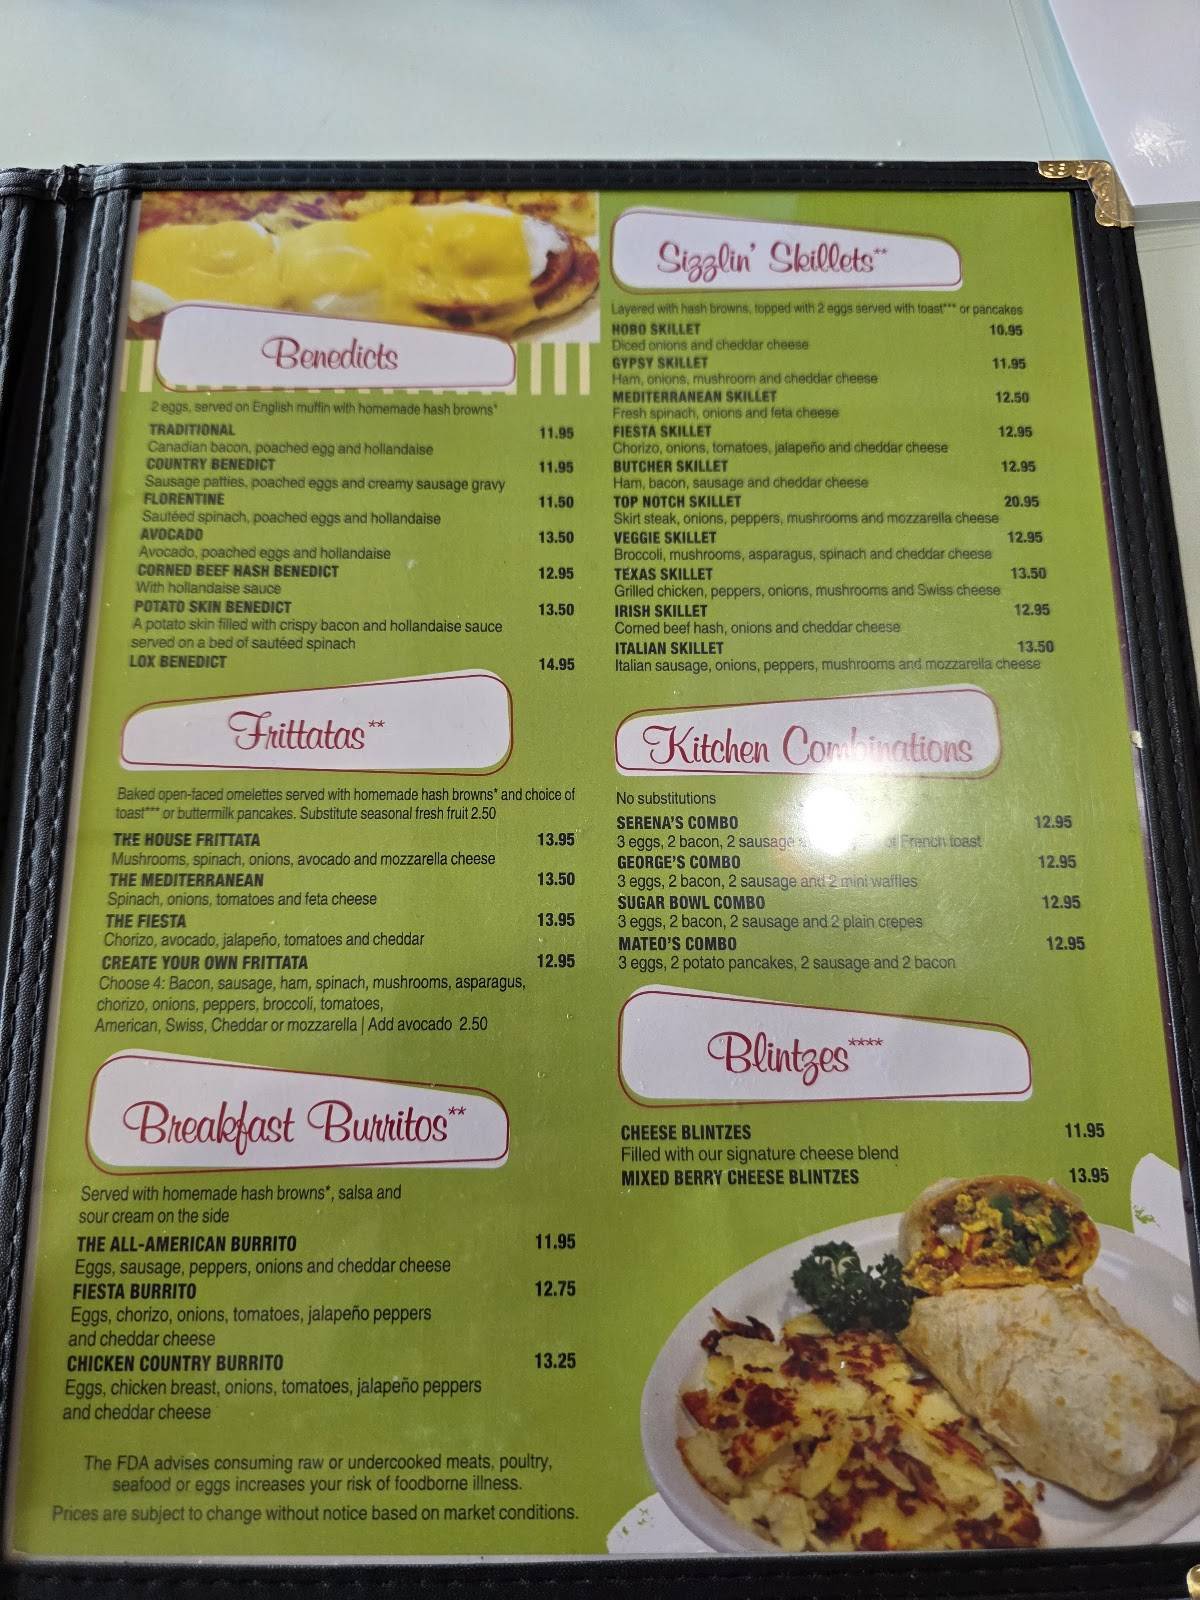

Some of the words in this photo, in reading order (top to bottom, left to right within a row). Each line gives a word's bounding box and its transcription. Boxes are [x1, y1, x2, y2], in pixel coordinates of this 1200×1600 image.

[657, 241, 755, 282] Sizzlin'
[611, 323, 646, 335] HOBO
[650, 322, 700, 335] SKILLET
[989, 323, 1023, 336] 10.95
[261, 337, 398, 370] Benedicts
[612, 356, 653, 369] GYPSY
[657, 356, 708, 369] SKILLET
[992, 357, 1026, 369] 11.95
[612, 389, 721, 403] MEDITERRANEAN
[725, 389, 776, 402] SKILLET
[995, 391, 1029, 403] 12.50
[149, 423, 235, 436] TRADITIONAL
[539, 426, 574, 439] 11.95
[613, 425, 656, 438] FIESTA
[660, 425, 711, 437] SKILLET
[998, 425, 1032, 438] 12.95
[146, 457, 207, 470] COUNTRY
[210, 458, 275, 471] BENEDICT
[539, 460, 573, 473] 11.95
[613, 460, 672, 473] BUTCHER
[676, 459, 728, 472] SKILLET
[1001, 460, 1036, 472] 12.95
[143, 492, 224, 505] FLORENTINE
[538, 495, 574, 508] 11.50
[613, 495, 638, 508] TOP
[642, 495, 684, 508] NOTCH
[689, 495, 741, 508] SKILLET
[1004, 495, 1039, 508] 20.95
[139, 528, 203, 541] AVOCADO
[538, 530, 574, 544] 13.50
[613, 531, 660, 544] VEGGIE
[664, 531, 716, 544] SKILLET
[1007, 530, 1043, 543] 12.95
[137, 564, 192, 576] CORNED
[195, 564, 229, 577] BEEF
[233, 564, 269, 577] HASH
[273, 564, 339, 578] BENEDICT
[538, 566, 574, 580] 12.95
[614, 567, 656, 581] TEXAS
[660, 567, 712, 581] SKILLET
[1010, 567, 1046, 579] 13.50
[136, 581, 164, 593] With
[167, 581, 240, 594] hollandaise
[242, 583, 281, 595] sauce
[614, 583, 653, 597] Grilled
[656, 584, 707, 599] chicken,
[710, 586, 764, 599] peppers,
[767, 583, 812, 598] onions,
[815, 583, 888, 596] mushrooms
[891, 583, 914, 596] and
[917, 583, 953, 596] Swiss
[956, 583, 1000, 596] cheese
[134, 600, 185, 613] POTATO
[188, 600, 221, 613] SKIN
[225, 600, 292, 614] BENEDICT
[538, 602, 574, 616] 13.50
[614, 604, 650, 617] IRISH
[654, 604, 707, 617] SKILLET
[1014, 603, 1050, 616] 12.95
[615, 641, 666, 655] ITALIAN
[670, 641, 724, 654] SKILLET
[1017, 639, 1054, 653] 13.50
[129, 655, 156, 668] LOX
[159, 655, 227, 668] BENEDICT
[538, 657, 575, 670] 14.95
[642, 726, 770, 764] Kitchen
[782, 725, 972, 765] Combinations
[616, 791, 634, 805] No
[637, 791, 716, 804] substitutions
[616, 815, 683, 830] SERENA'S
[687, 815, 738, 829] COMBO
[1034, 814, 1072, 829] 12.95
[113, 832, 140, 846] THE
[144, 832, 192, 847] HOUSE
[195, 832, 260, 847] FRITTATA
[537, 832, 574, 846] 13.95
[112, 851, 188, 866] Mushrooms,
[193, 852, 244, 868] spinach,
[249, 852, 293, 866] onions,
[297, 851, 350, 866] avocado
[353, 851, 377, 866] and
[380, 851, 447, 866] mozzarella
[450, 850, 495, 866] cheese
[617, 854, 685, 869] GEORGE'S
[689, 854, 740, 869] COMBO
[1038, 854, 1077, 869] 12.95
[109, 873, 137, 887] THE
[140, 873, 264, 887] MEDITERRANEAN
[537, 871, 575, 886] 13.50
[617, 895, 665, 910] SUGAR
[669, 895, 710, 910] BOWL
[713, 895, 765, 909] COMBO
[1042, 894, 1081, 909] 12.95
[105, 913, 133, 928] THE
[137, 913, 186, 928] FIESTA
[537, 912, 575, 927] 13.95
[618, 936, 681, 951] MATEO'S
[685, 936, 736, 951] COMBO
[1046, 936, 1085, 951] 12.95
[101, 955, 157, 970] CREATE
[161, 955, 200, 970] YOUR
[204, 955, 238, 970] OWN
[242, 955, 308, 970] FRITTATA
[537, 953, 575, 968] 12.95
[123, 1100, 295, 1154] Breakfast
[620, 1124, 677, 1141] CHEESE
[681, 1124, 751, 1140] BLINTZES
[1064, 1122, 1104, 1138] 11.95
[621, 1145, 660, 1162] Filled
[664, 1145, 694, 1162] with
[698, 1149, 723, 1161] our
[726, 1145, 795, 1163] signature
[799, 1145, 853, 1161] cheese
[857, 1144, 899, 1160] blend
[621, 1169, 669, 1186] MIXED
[674, 1169, 722, 1186] BERRY
[727, 1168, 784, 1185] CHEESE
[788, 1168, 859, 1185] BLINTZES
[1069, 1167, 1109, 1183] 13.95
[81, 1185, 129, 1202] Served
[132, 1185, 158, 1201] with
[162, 1184, 237, 1201] homemade
[241, 1184, 273, 1200] hash
[338, 1184, 373, 1200] salsa
[376, 1184, 401, 1200] and
[77, 1236, 105, 1252] THE
[109, 1235, 226, 1252] ALL-AMERICAN
[230, 1235, 296, 1252] BURRITO
[535, 1233, 575, 1249] 11.95
[72, 1282, 124, 1300] FIESTA
[130, 1282, 196, 1299] BURRITO
[535, 1280, 575, 1297] 12.75
[67, 1354, 134, 1372] CHICKEN
[139, 1354, 211, 1372] COUNTRY
[216, 1354, 283, 1371] BURRITO
[534, 1351, 576, 1369] 13.25
[52, 1504, 98, 1521] Prices
[102, 1508, 127, 1521] are
[131, 1505, 184, 1524] subject
[188, 1506, 203, 1521] to
[206, 1504, 262, 1524] change
[265, 1504, 319, 1521] without
[323, 1504, 367, 1521] notice
[371, 1504, 417, 1521] based
[421, 1507, 439, 1520] on
[443, 1503, 495, 1520] market
[498, 1503, 579, 1520] conditions.
